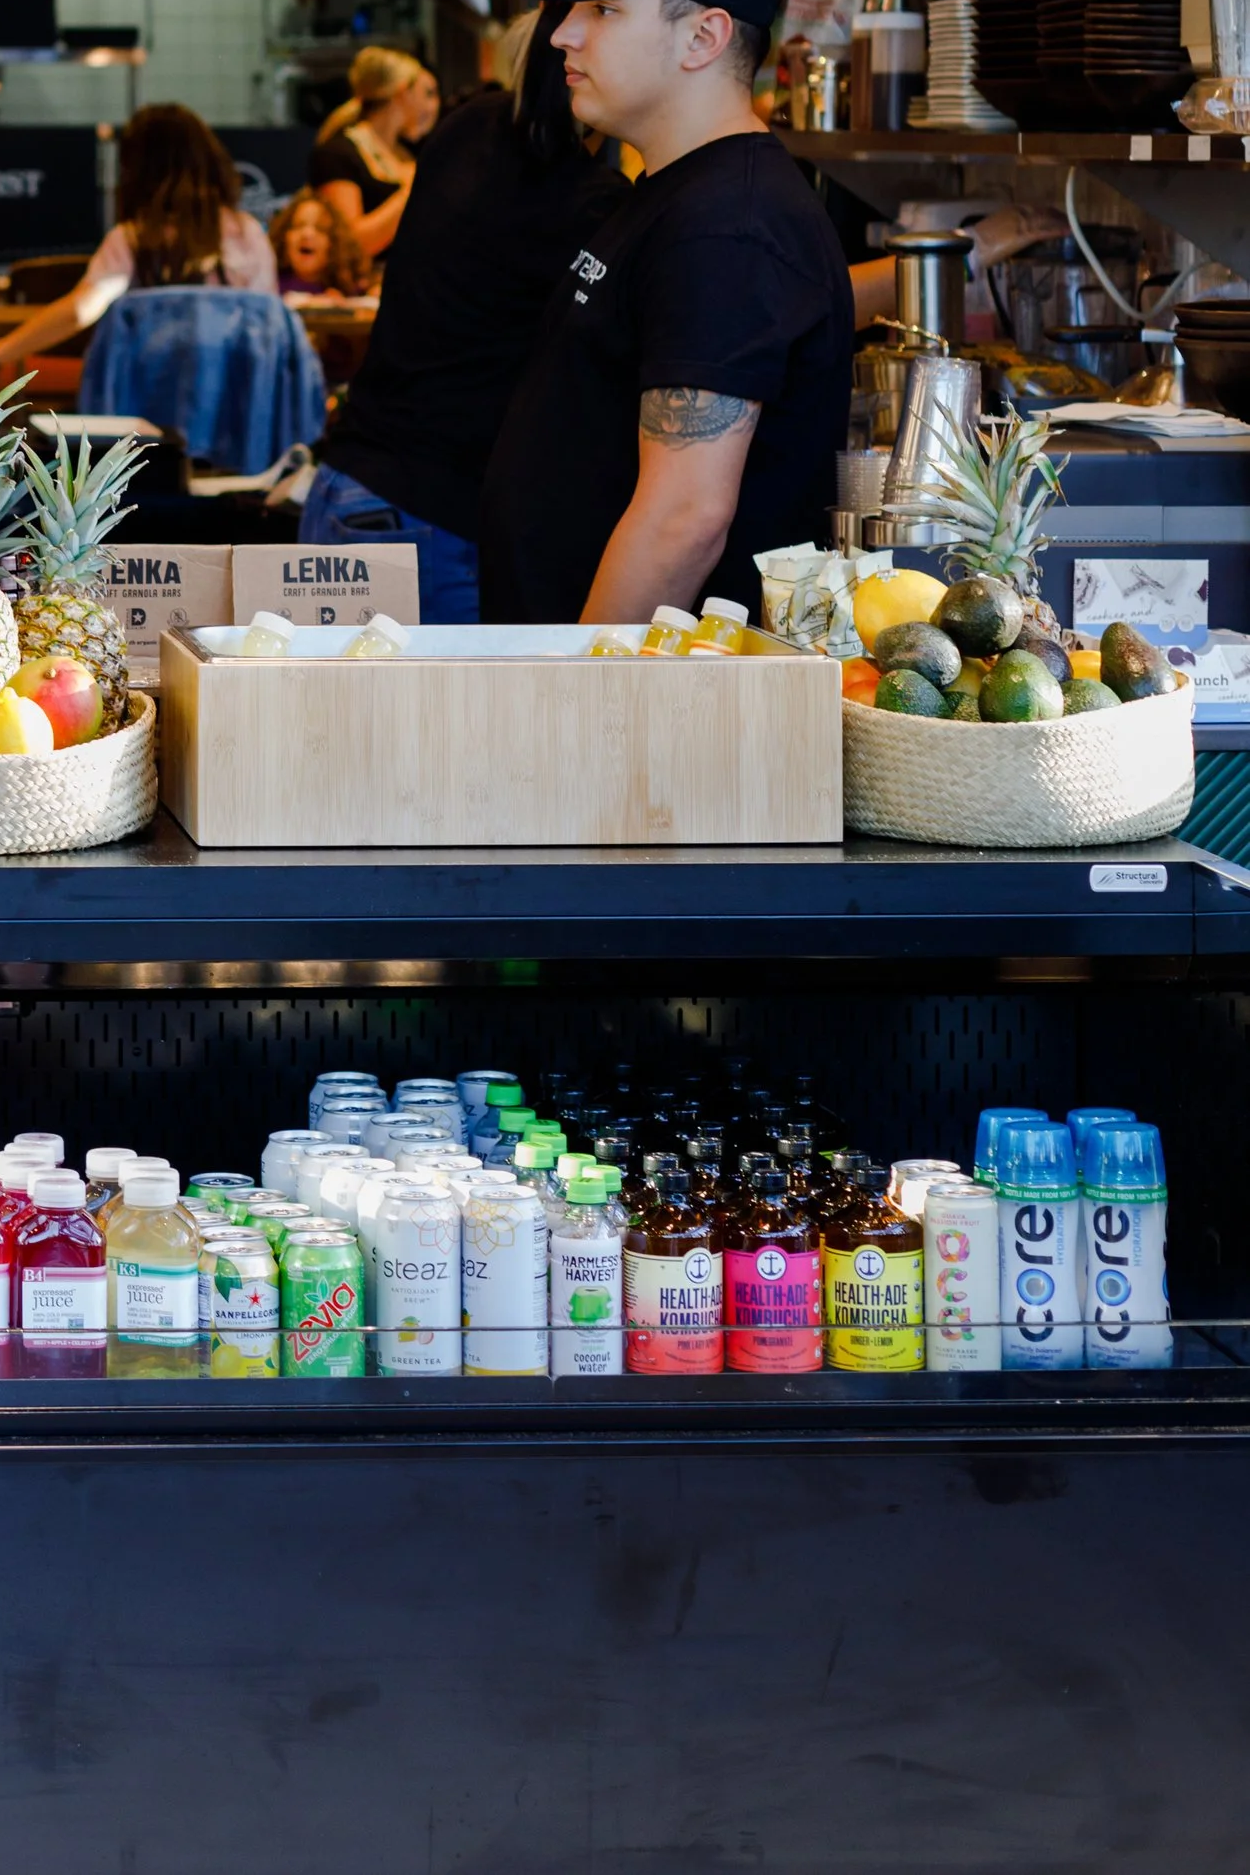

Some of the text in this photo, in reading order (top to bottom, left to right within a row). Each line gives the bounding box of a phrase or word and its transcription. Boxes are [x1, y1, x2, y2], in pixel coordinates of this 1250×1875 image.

[283, 557, 369, 583] LENKA
[122, 589, 158, 598] GRANOLA
[162, 589, 181, 597] BARS
[283, 587, 370, 597] CRAFT GRANOLA BARS
[1086, 607, 1154, 621] cookies and
[1193, 676, 1229, 686] unch
[1116, 871, 1158, 880] Structural
[1042, 1191, 1058, 1199] FROM
[1100, 1191, 1116, 1200] MADE
[1133, 1207, 1143, 1267] HYDRATION
[562, 1254, 618, 1269] HARMLESS
[24, 1269, 44, 1281] B4
[119, 1263, 137, 1276] K8
[565, 1268, 615, 1282] HARVEST
[1015, 1204, 1055, 1342] core
[1093, 1205, 1132, 1342] core
[32, 1296, 74, 1310] juice
[127, 1290, 164, 1305] juice
[735, 1307, 809, 1331] KOMBUCHA
[835, 1305, 908, 1331] KOMBUCHA
[391, 1356, 441, 1365] GREEN TEA
[574, 1351, 610, 1363] coconut
[578, 1363, 607, 1372] water
